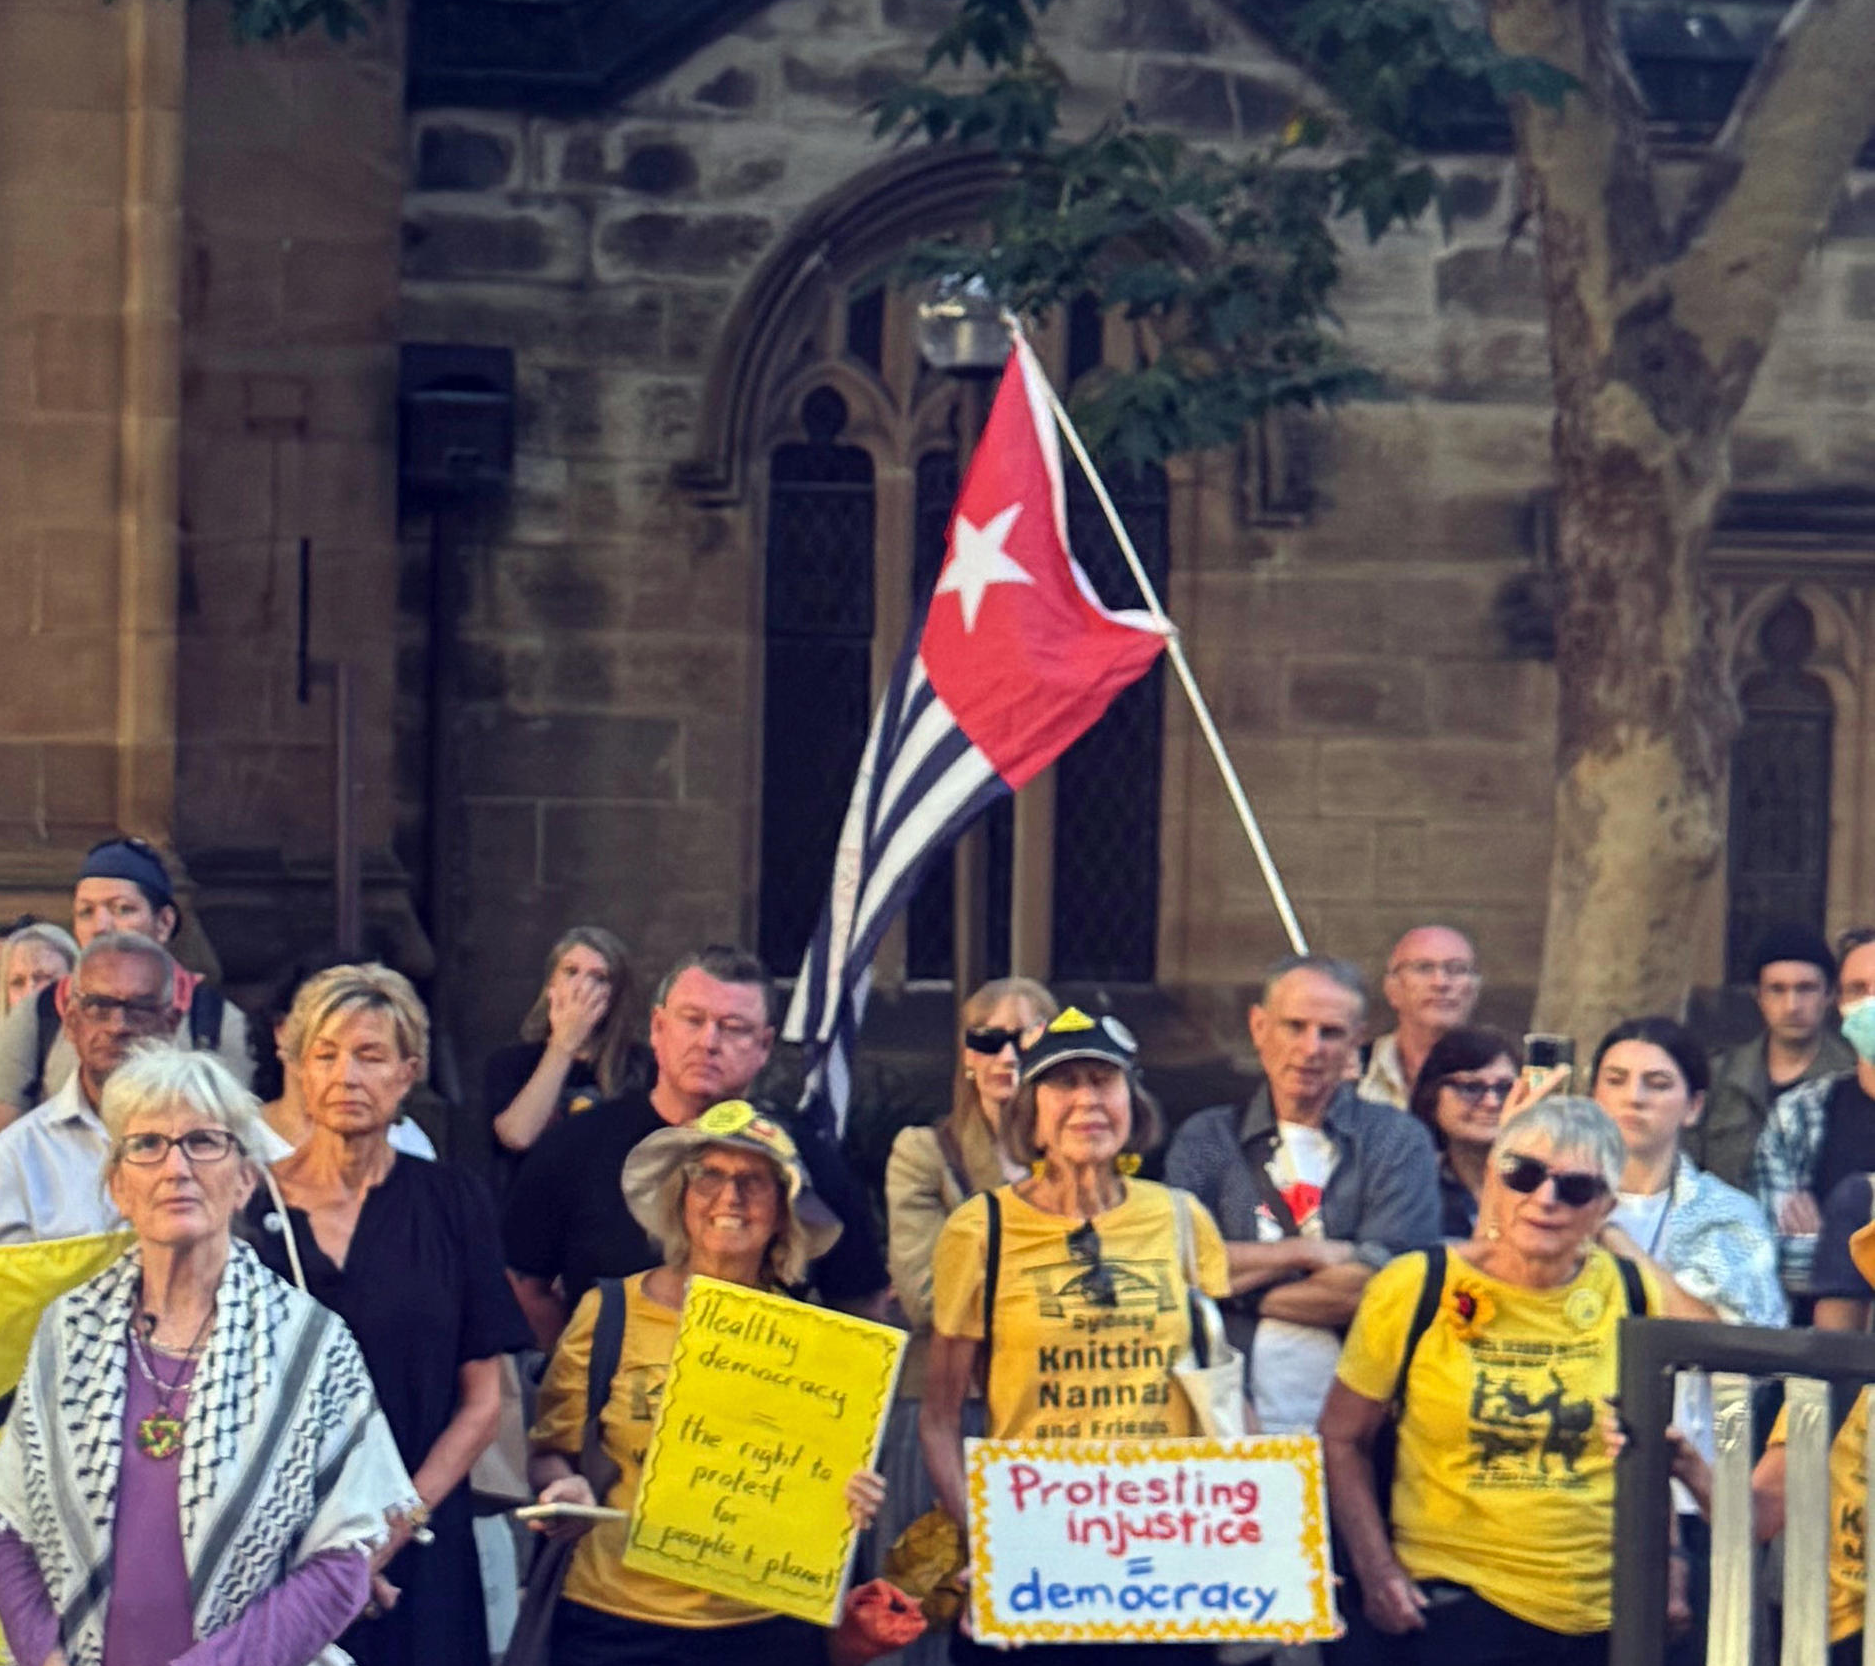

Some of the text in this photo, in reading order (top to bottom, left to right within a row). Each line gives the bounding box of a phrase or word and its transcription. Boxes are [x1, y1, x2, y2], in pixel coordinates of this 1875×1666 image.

[696, 1298, 800, 1366] Healthy
[699, 1345, 847, 1419] democracy
[680, 1413, 832, 1482] the right to
[690, 1466, 784, 1503] protest
[713, 1496, 741, 1524] for
[1008, 1464, 1260, 1515] Protesting
[660, 1525, 735, 1559] people
[762, 1552, 833, 1589] planet
[1067, 1509, 1263, 1556] injustice
[1009, 1567, 1278, 1622] democracy
